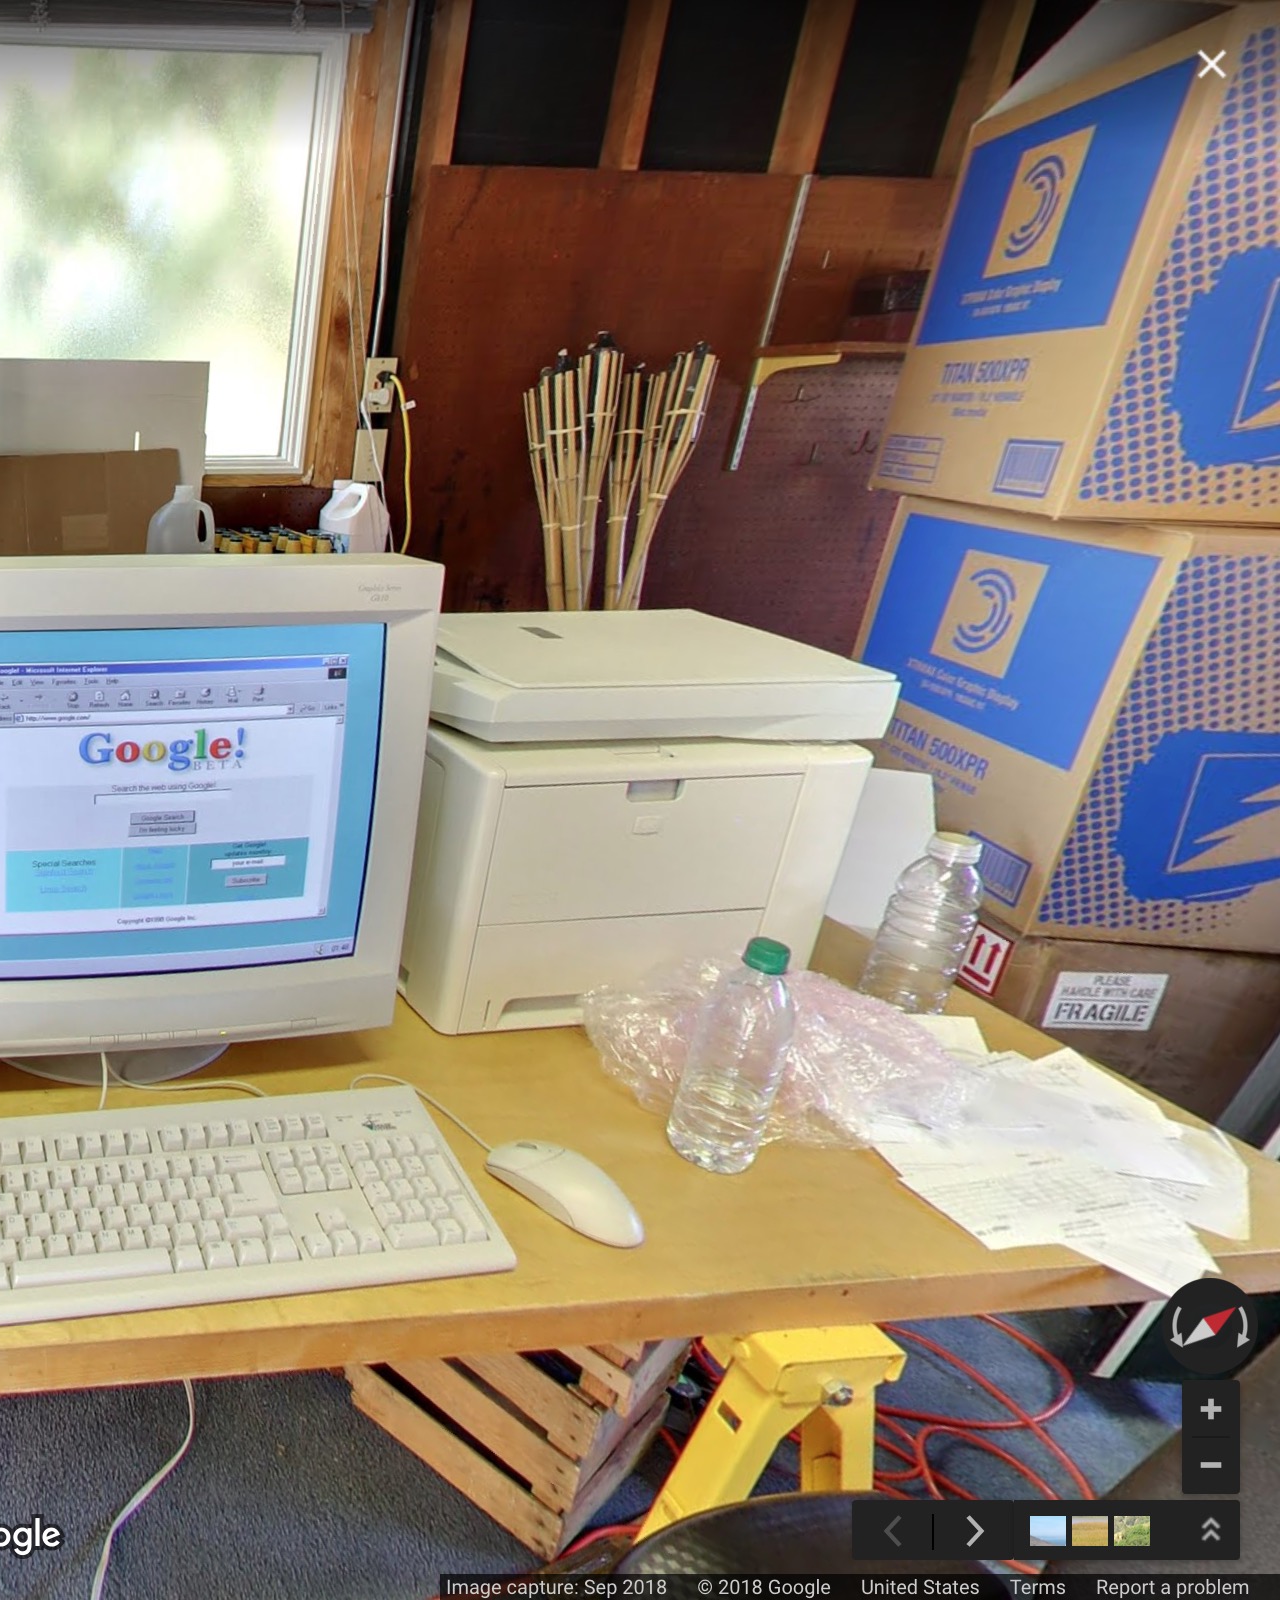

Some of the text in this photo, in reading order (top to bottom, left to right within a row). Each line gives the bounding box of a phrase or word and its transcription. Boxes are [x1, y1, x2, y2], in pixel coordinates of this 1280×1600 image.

[941, 357, 1030, 385] TITAN 500XPR
[79, 727, 245, 772] Google!
[890, 717, 929, 752] TITAN
[928, 736, 990, 781] 500XPR
[193, 759, 242, 771] BETA
[111, 784, 137, 793] Search
[167, 783, 187, 792] using
[32, 858, 97, 869] Special Searches
[1093, 975, 1133, 986] PLEASE
[1102, 987, 1128, 998] WITH
[1128, 988, 1158, 999] CARE
[1054, 1002, 1150, 1023] FRAGILE
